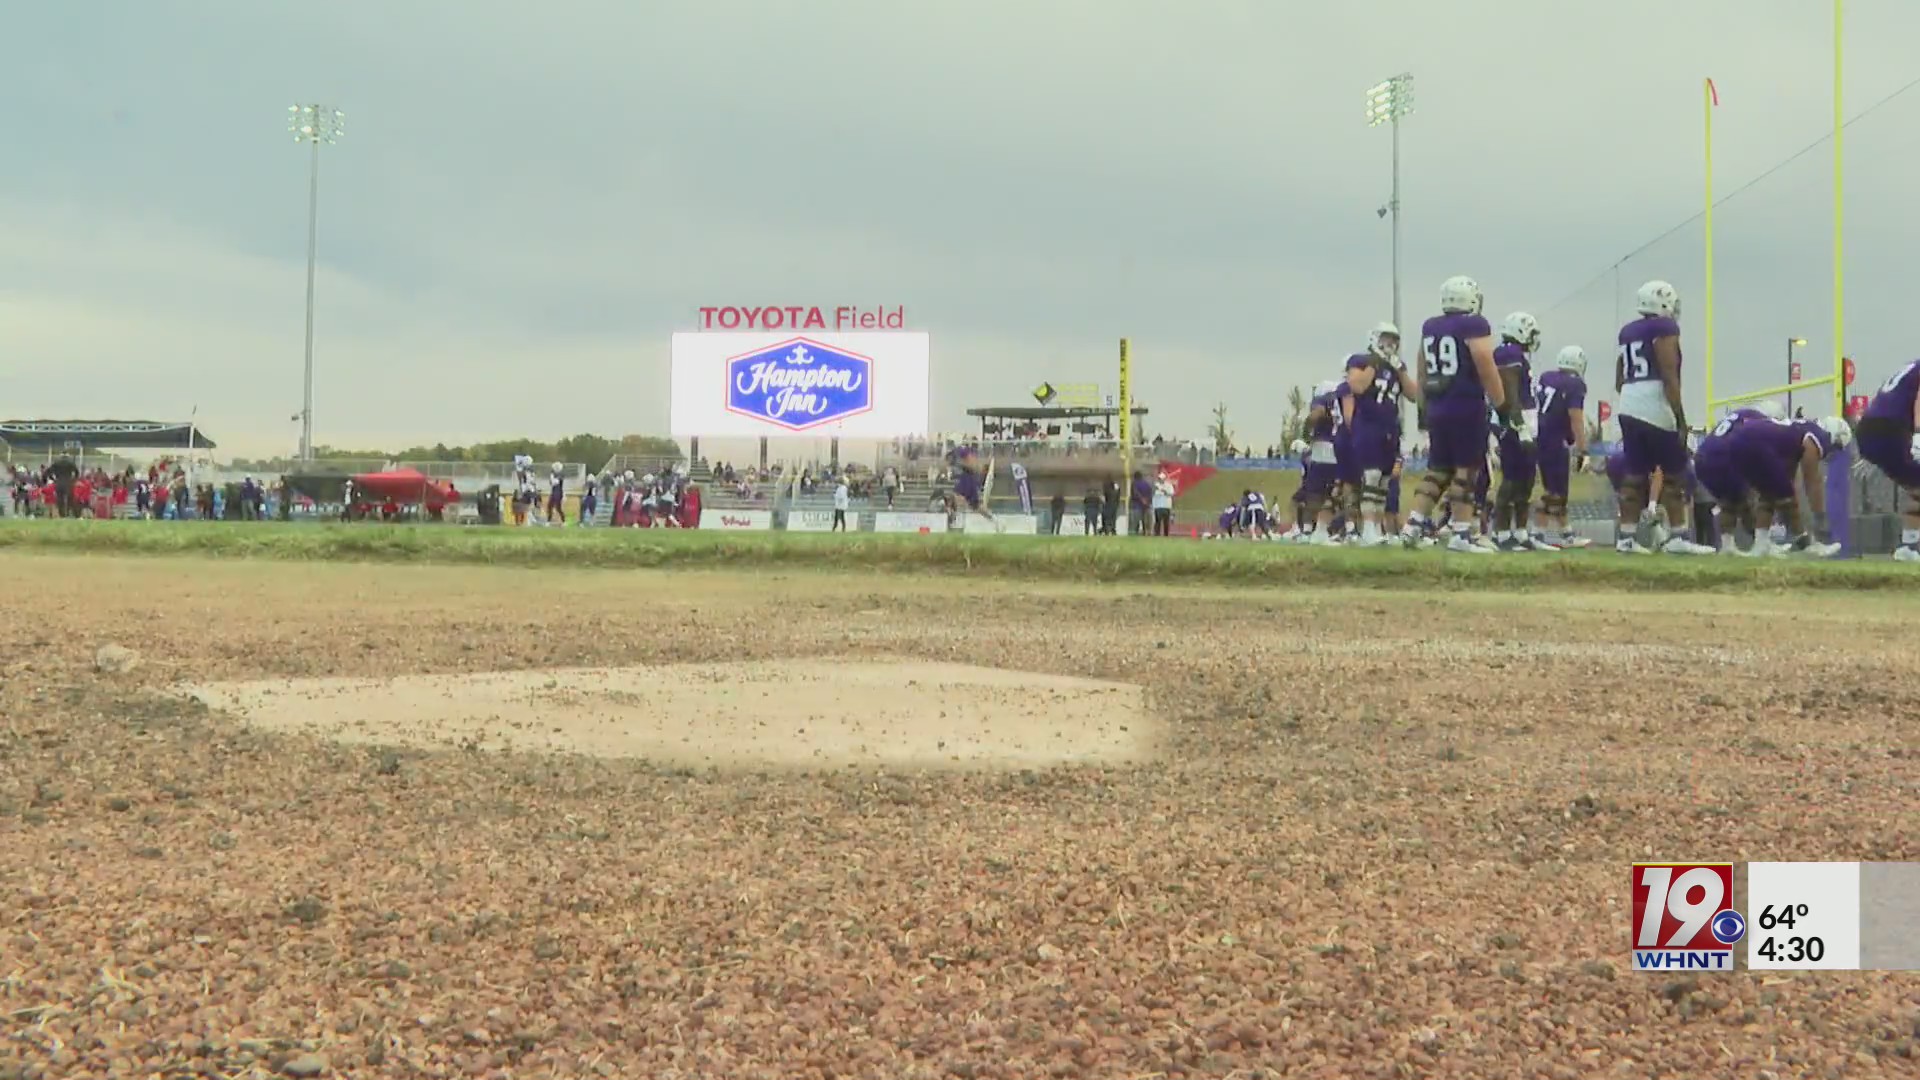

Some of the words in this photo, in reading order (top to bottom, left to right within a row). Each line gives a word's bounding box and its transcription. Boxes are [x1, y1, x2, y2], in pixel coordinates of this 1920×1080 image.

[700, 306, 826, 329] TOYOTA
[836, 305, 904, 329] Field
[1423, 333, 1459, 376] 59
[737, 362, 862, 395] Hampton
[766, 387, 828, 419] Inn
